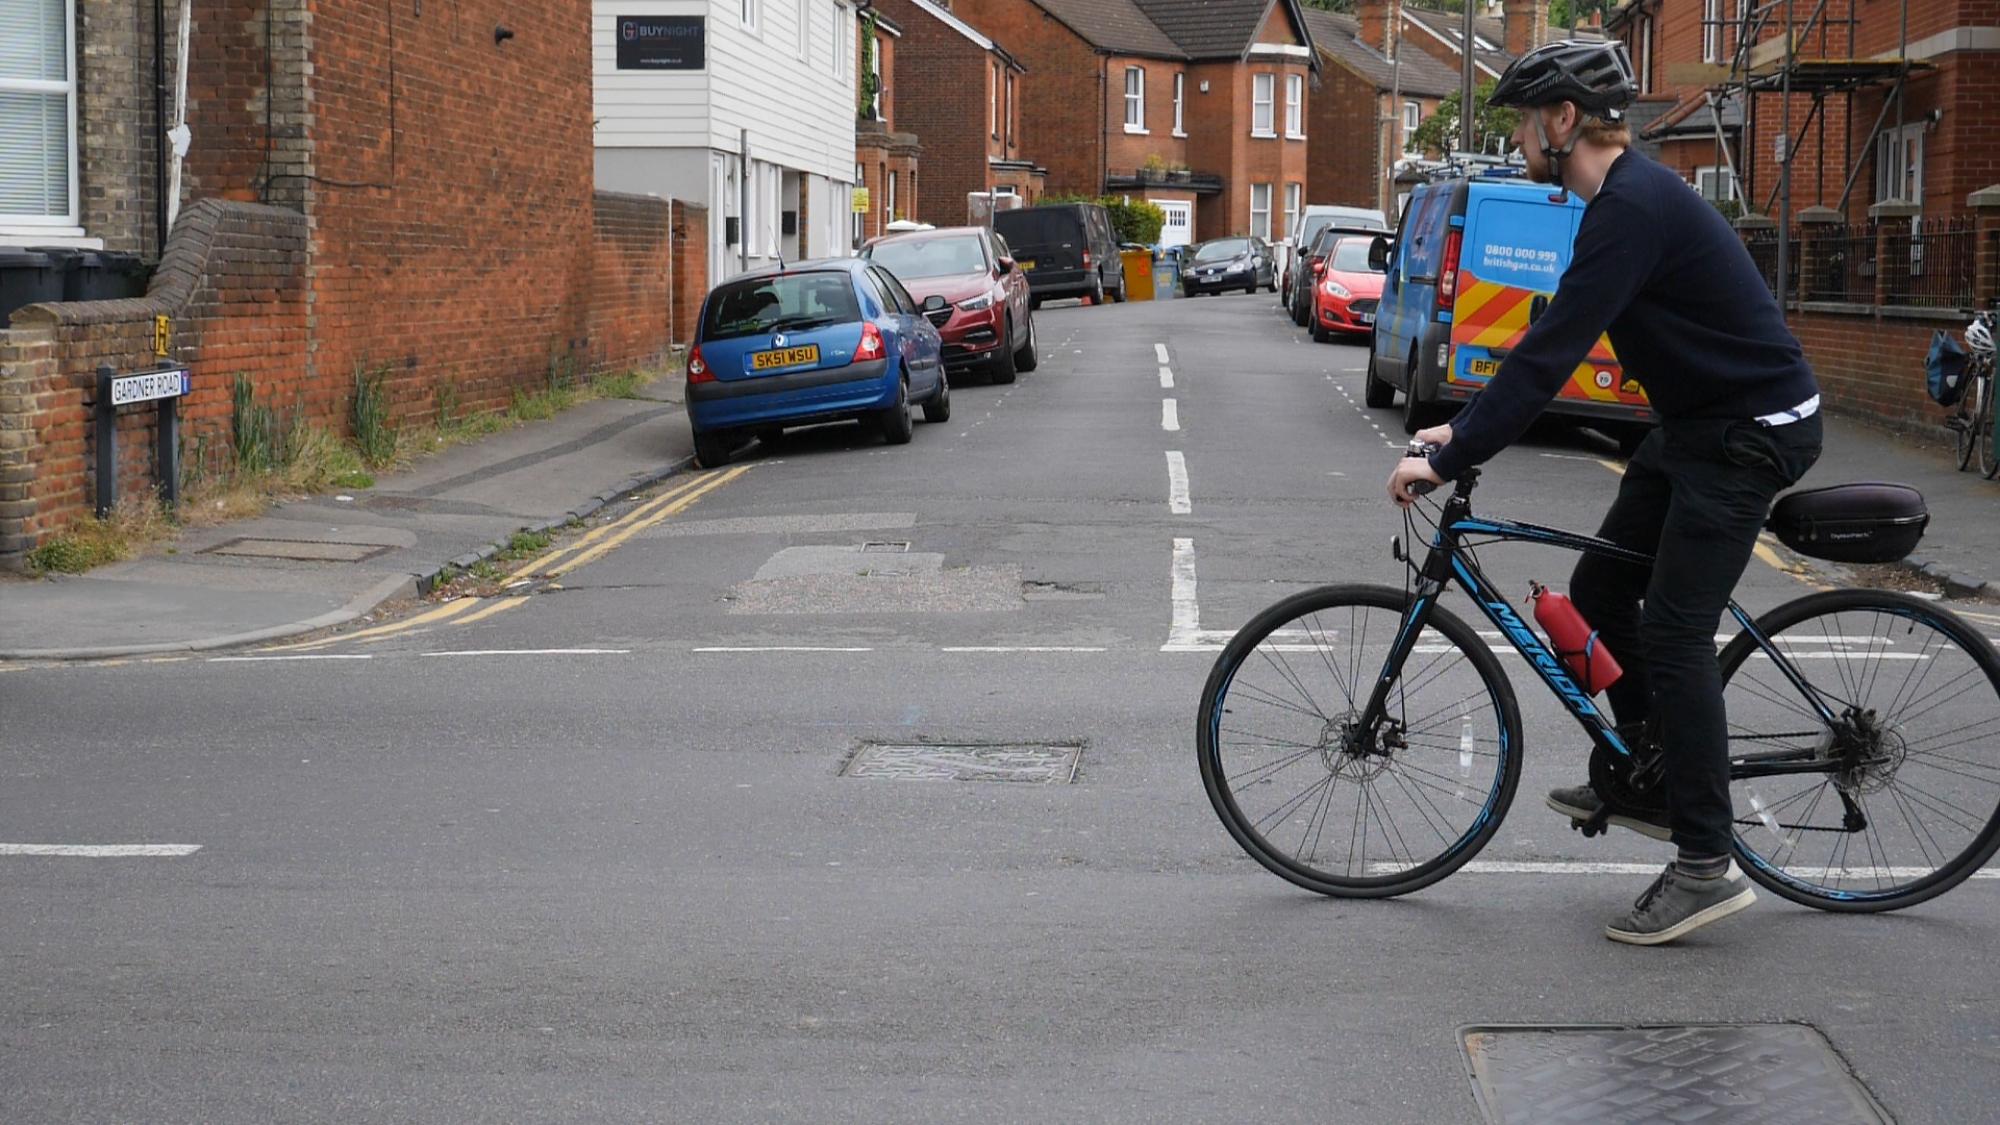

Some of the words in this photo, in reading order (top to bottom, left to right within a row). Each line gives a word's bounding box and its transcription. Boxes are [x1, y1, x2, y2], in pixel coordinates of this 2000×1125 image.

[639, 26, 699, 36] BUYNIGHT
[1485, 244, 1513, 257] 0800
[1514, 247, 1535, 259] 000
[1536, 250, 1557, 261] 999
[1483, 256, 1555, 273] britishgas.co.uk
[756, 353, 786, 367] SK51
[788, 349, 813, 364] WSU
[1475, 361, 1497, 374] BF1
[115, 377, 155, 401] GARDNER
[157, 375, 179, 395] ROAD
[1487, 602, 1599, 715] MERIDA
